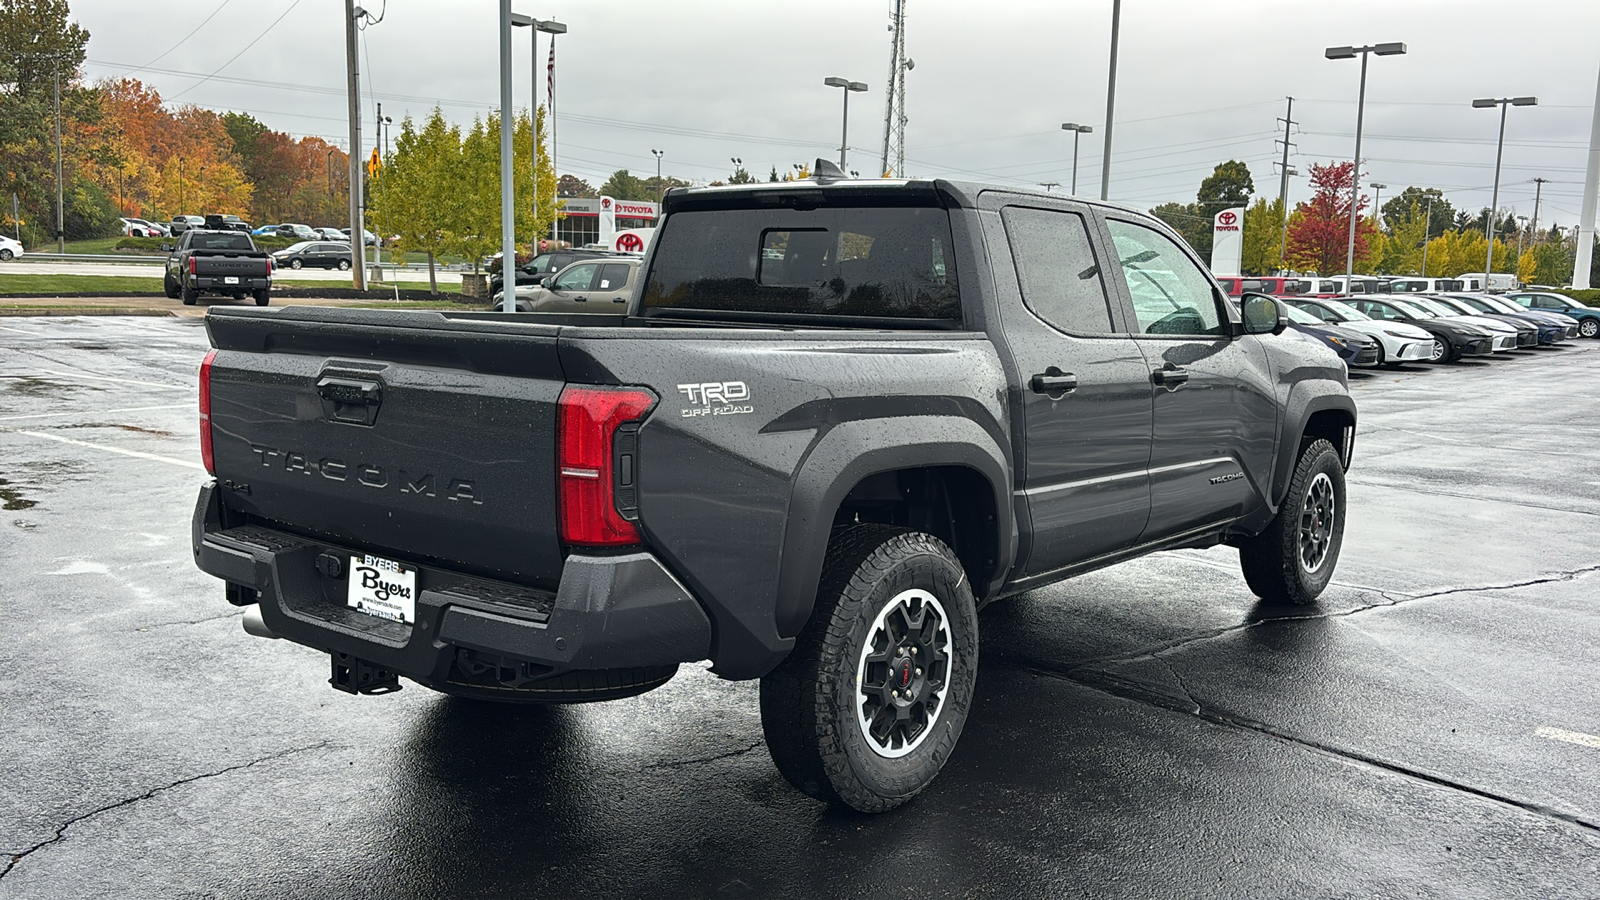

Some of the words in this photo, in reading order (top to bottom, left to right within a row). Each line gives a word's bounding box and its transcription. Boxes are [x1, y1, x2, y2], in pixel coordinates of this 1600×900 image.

[623, 205, 653, 214] TOYOTA
[677, 381, 750, 407] TRD
[682, 407, 711, 417] OFF
[713, 404, 754, 416] ROAD
[251, 443, 483, 505] TACOMA
[1209, 471, 1244, 485] TACOMA
[364, 554, 400, 573] BYERS
[355, 566, 411, 601] Byers
[362, 596, 403, 611] www.byersauto.com
